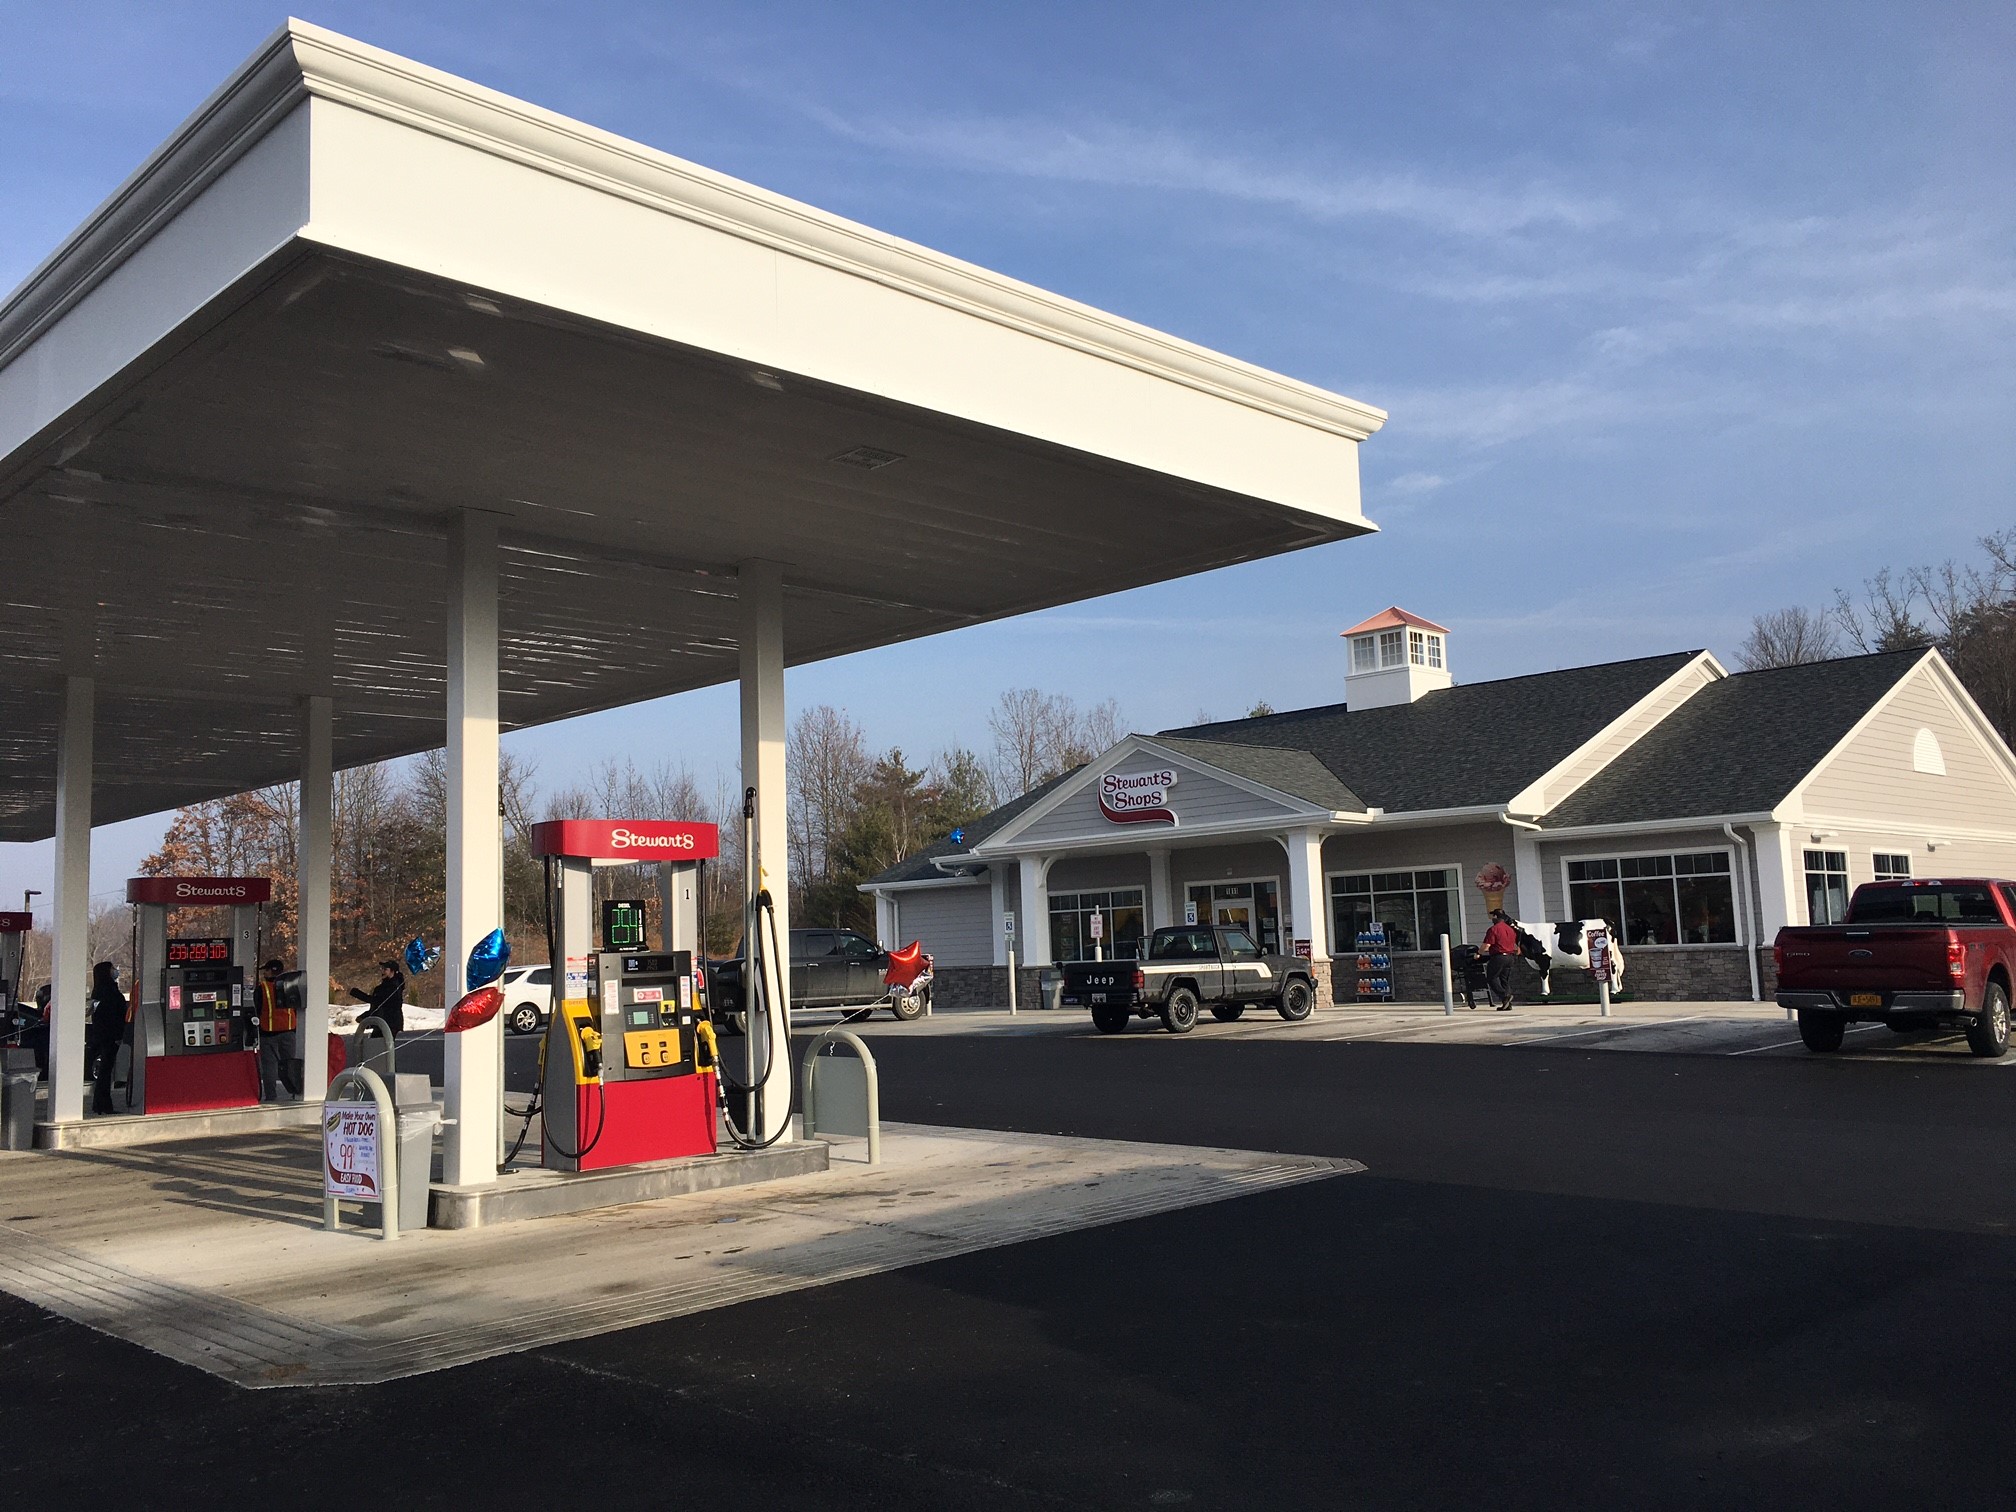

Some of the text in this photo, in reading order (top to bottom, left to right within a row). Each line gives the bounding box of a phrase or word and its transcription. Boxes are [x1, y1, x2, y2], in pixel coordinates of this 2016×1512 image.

[1115, 791, 1162, 809] Shops
[611, 828, 694, 850] Stewart's
[685, 889, 690, 900] 1
[243, 931, 250, 940] 3
[1587, 930, 1605, 938] Coffee
[1086, 975, 1115, 986] Jeep
[341, 1111, 376, 1121] Make Your Own
[343, 1122, 374, 1136] HOT DOG
[340, 1172, 363, 1184] EASY FOOD
